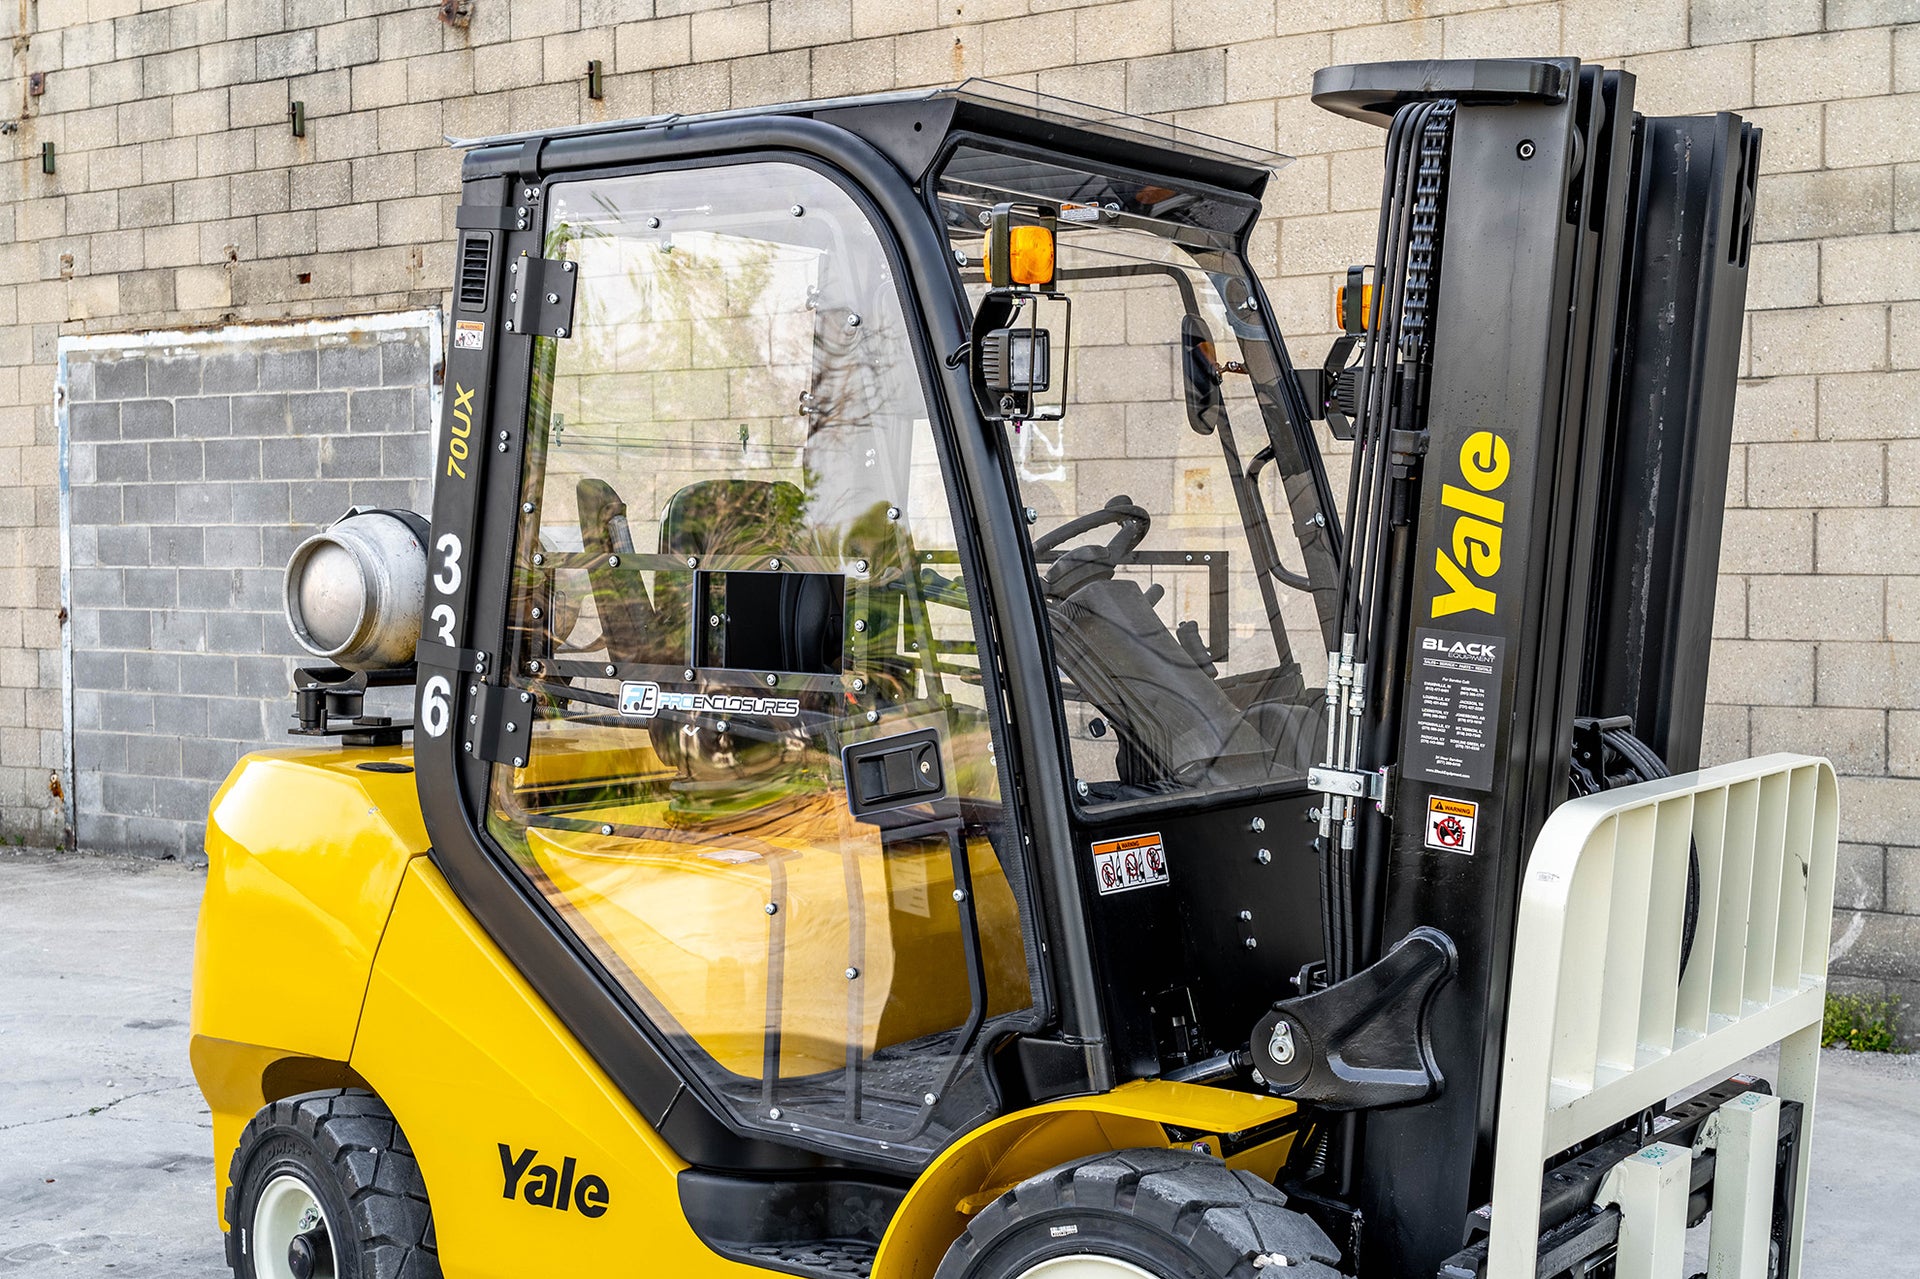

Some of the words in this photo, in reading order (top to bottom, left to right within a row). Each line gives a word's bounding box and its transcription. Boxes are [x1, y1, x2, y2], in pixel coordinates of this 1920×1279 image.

[447, 382, 476, 480] 70UX
[1431, 431, 1511, 618] Yale
[1422, 637, 1496, 658] BLACK
[1448, 652, 1495, 663] EQUIPMENT
[659, 694, 799, 715] PROENCLOSURES
[1444, 805, 1471, 815] WARNING
[1121, 840, 1140, 849] WARNING
[498, 1143, 610, 1219] Yale
